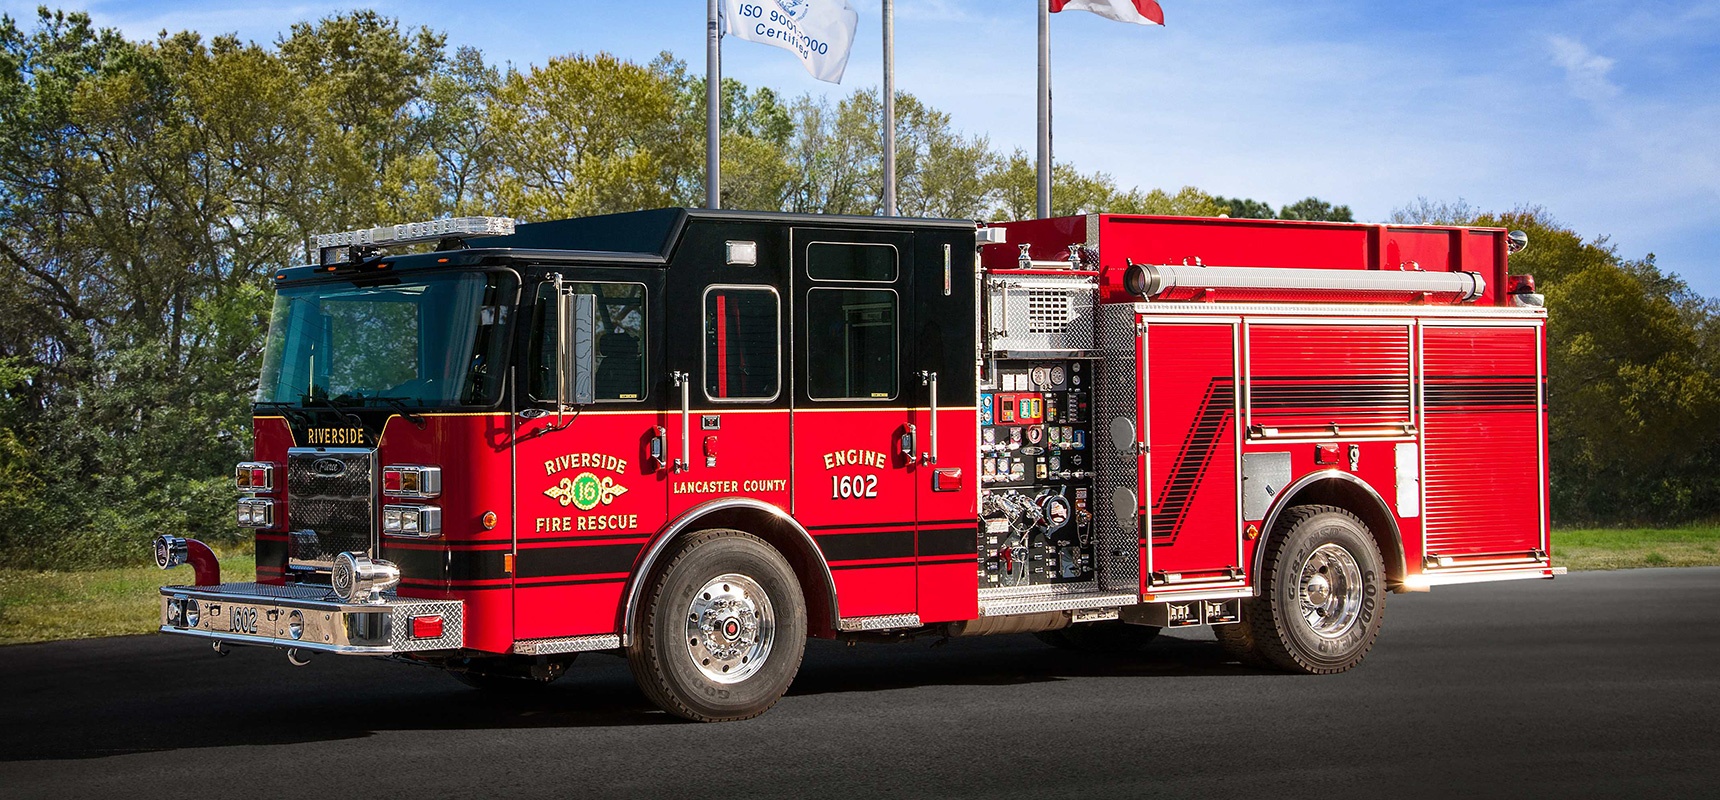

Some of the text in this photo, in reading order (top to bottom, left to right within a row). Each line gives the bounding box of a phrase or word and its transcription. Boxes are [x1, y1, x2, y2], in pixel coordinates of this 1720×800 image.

[738, 3, 763, 19] ISO
[755, 23, 809, 59] Certified
[308, 428, 364, 444] RIVERSIDE
[544, 452, 628, 476] RIVERSIDE
[823, 449, 887, 470] ENGINE
[578, 481, 596, 501] 16
[673, 479, 787, 495] LANCASTER COUNTY
[831, 474, 878, 499] 1602
[535, 514, 638, 533] FIRE RESCUE
[1288, 548, 1306, 601] G282
[230, 606, 258, 634] 1602
